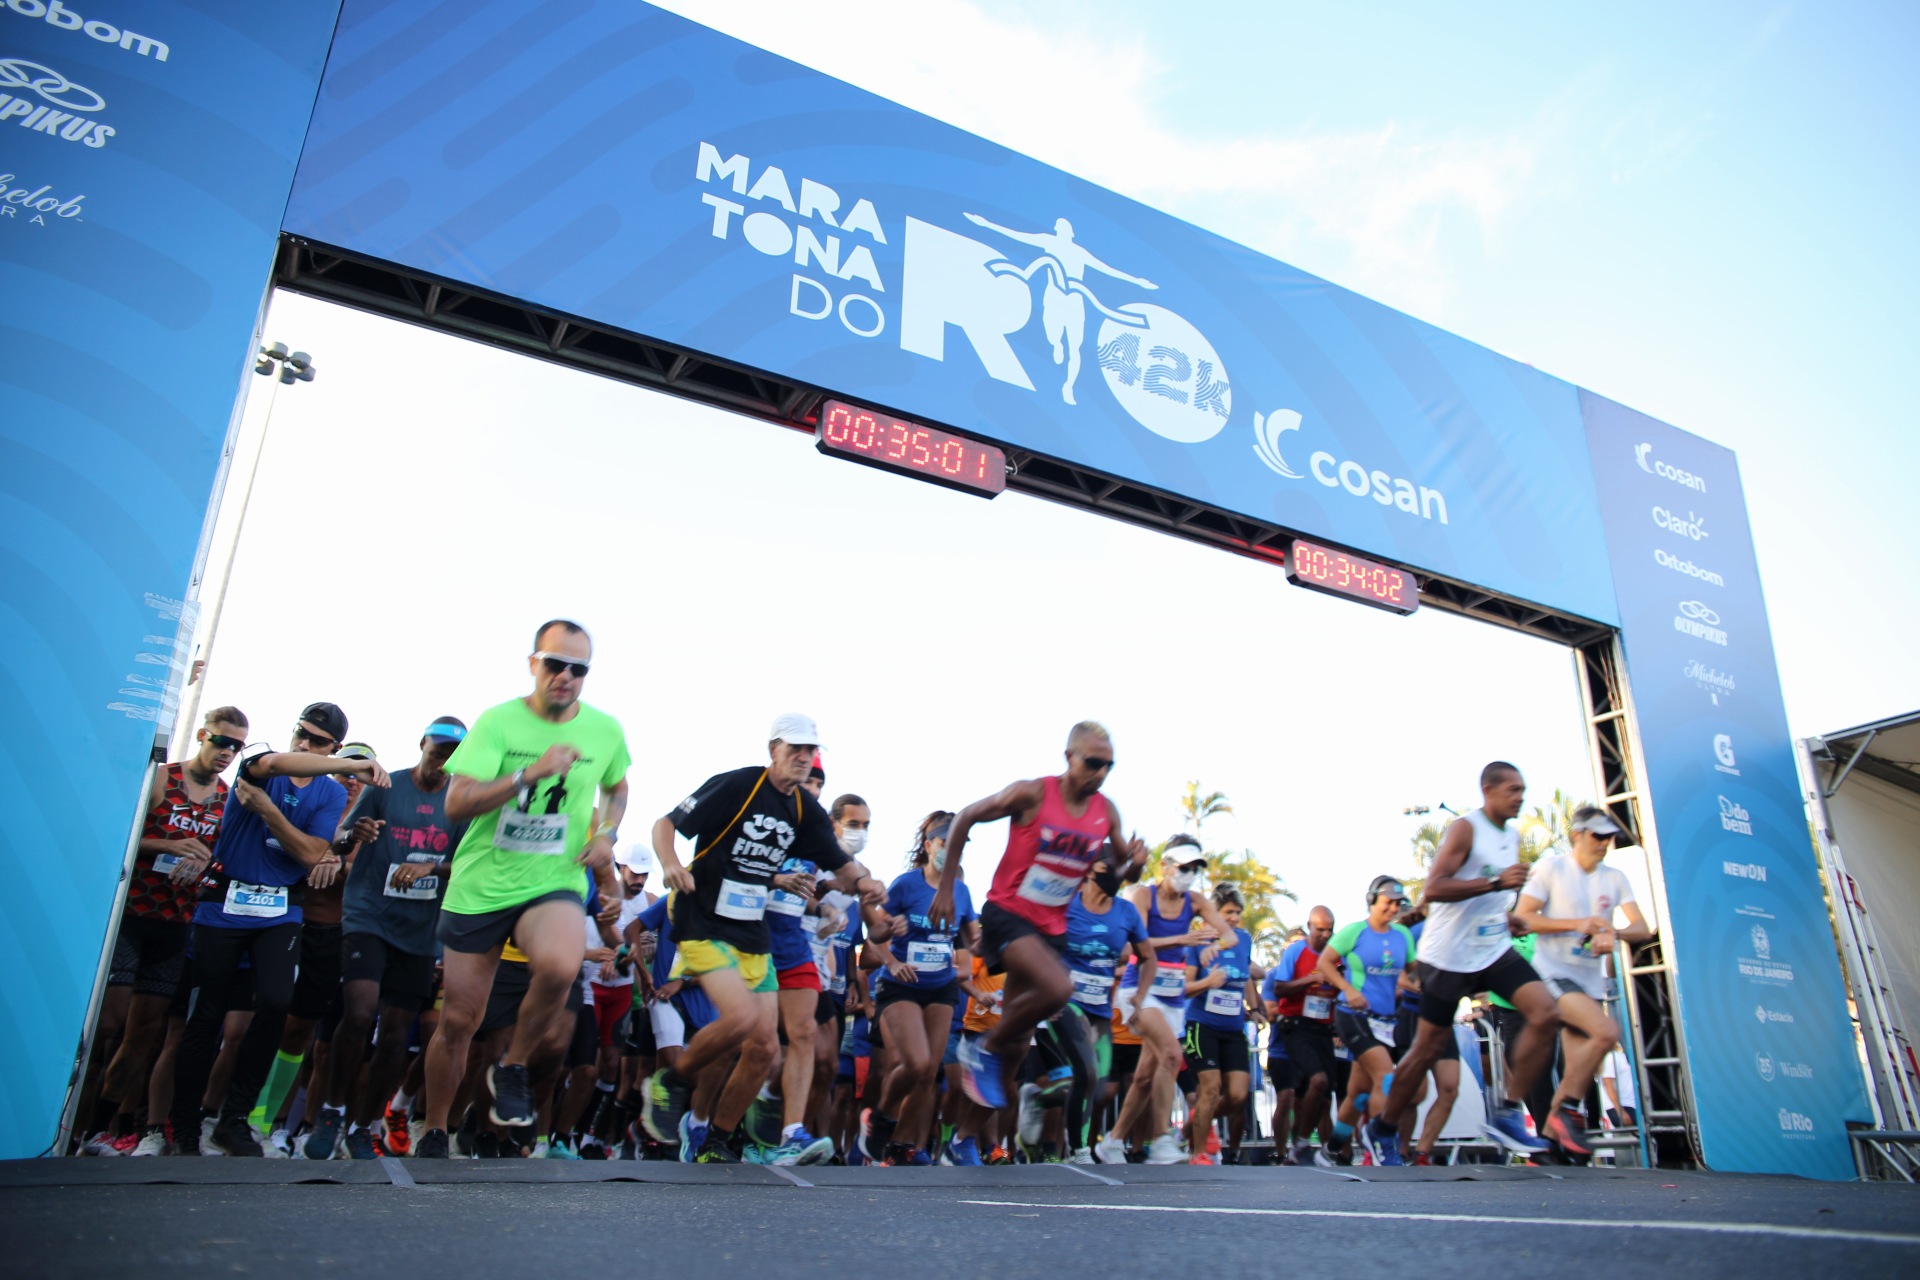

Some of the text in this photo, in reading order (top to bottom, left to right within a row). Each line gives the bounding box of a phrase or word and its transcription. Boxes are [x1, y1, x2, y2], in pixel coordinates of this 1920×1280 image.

[0, 0, 169, 62] obom
[696, 141, 887, 245] MARA
[702, 192, 886, 292] TONA
[790, 273, 885, 337] DO
[827, 407, 985, 478] 00:35:01
[1309, 451, 1448, 525] cosan
[1654, 461, 1706, 493] cosan
[1652, 506, 1701, 541] Claro
[1295, 545, 1402, 602] 00:34:02
[1654, 549, 1724, 587] Ortobom
[1674, 616, 1728, 646] OLYMPIKUS
[1684, 659, 1735, 690] Michelob
[168, 813, 216, 836] KENYA
[1720, 812, 1753, 836] bem
[1733, 804, 1750, 821] do
[246, 894, 275, 906] 2101
[1764, 968, 1794, 981] JANEIRO
[1791, 1112, 1813, 1131] Rio
